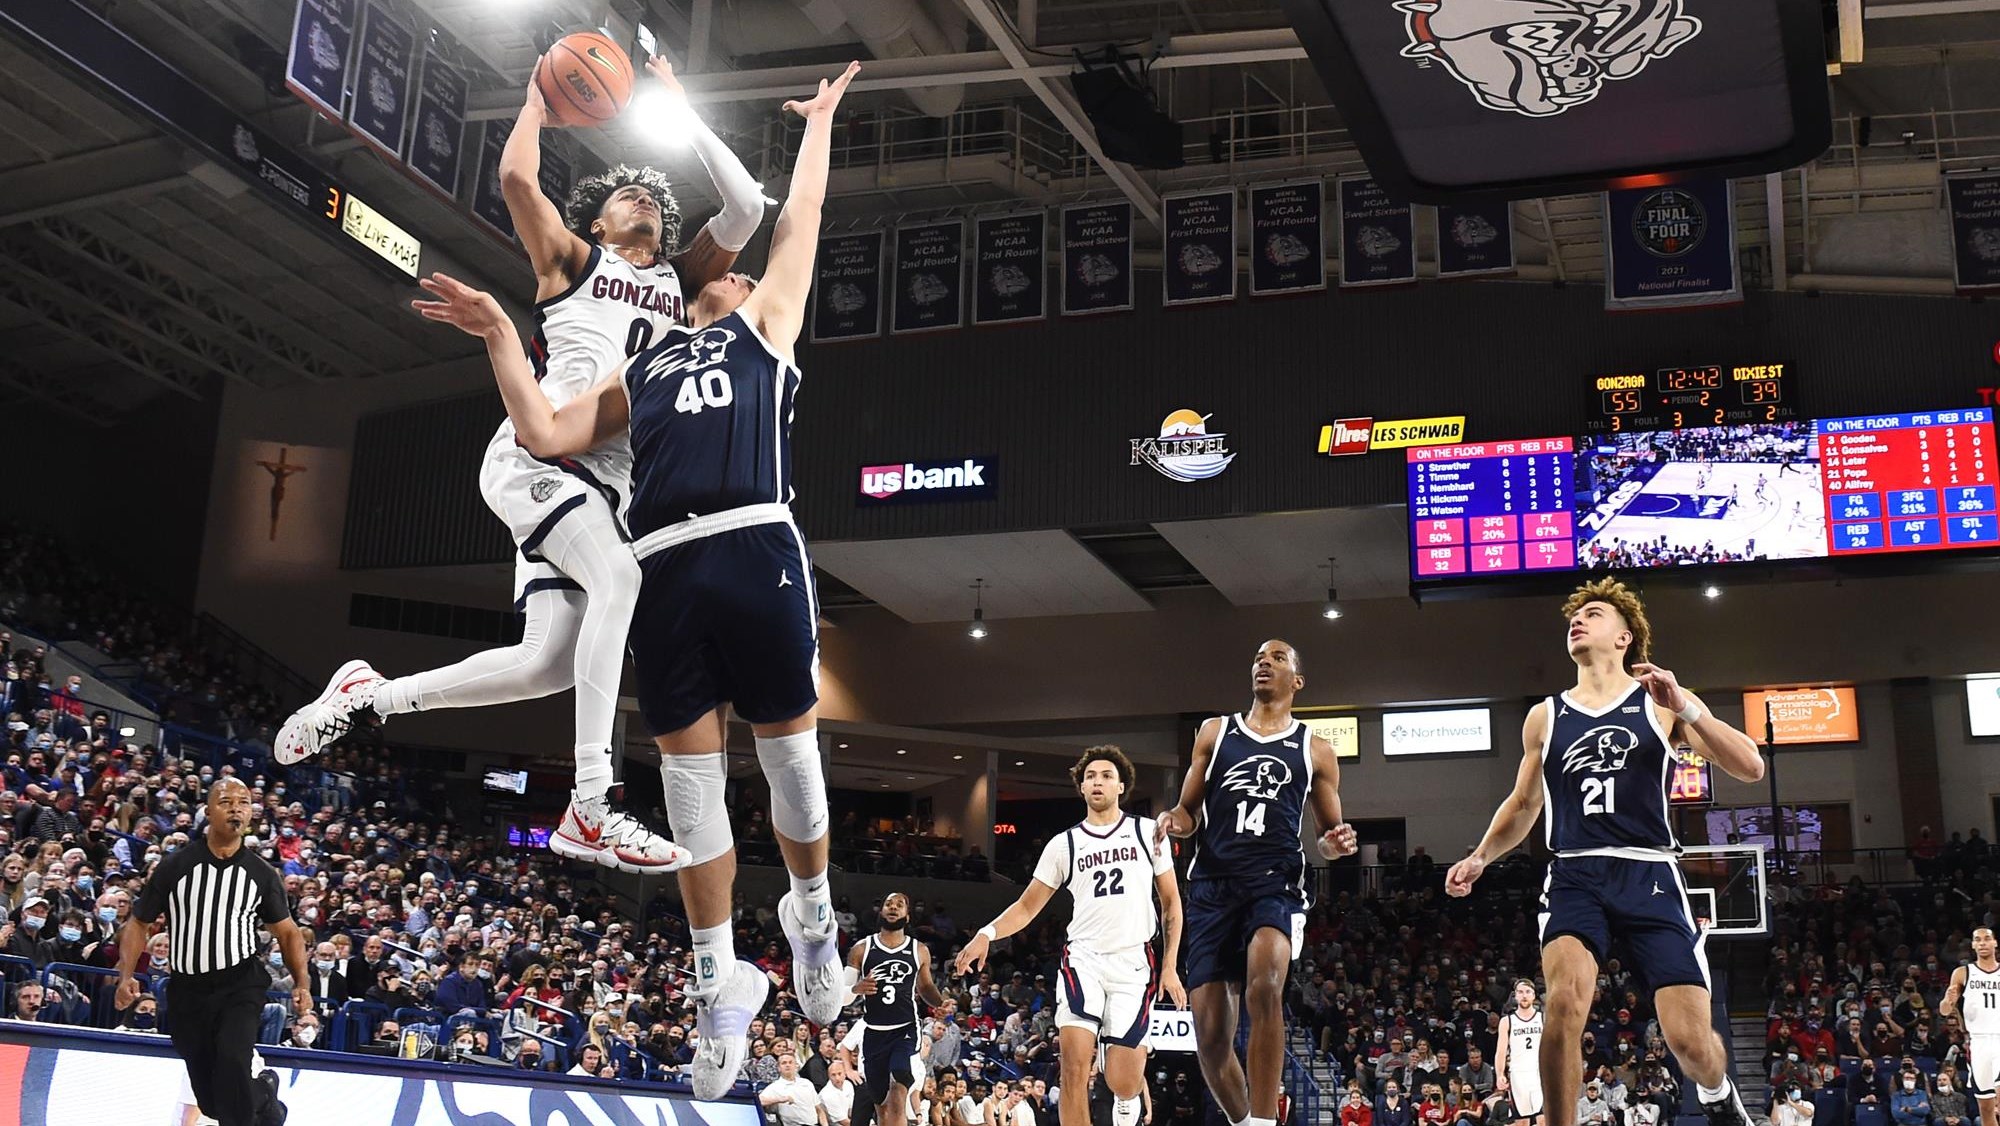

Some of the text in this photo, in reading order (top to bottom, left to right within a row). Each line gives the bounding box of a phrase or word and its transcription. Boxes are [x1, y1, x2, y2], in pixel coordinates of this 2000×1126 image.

[325, 187, 340, 220] 3
[1271, 205, 1303, 216] NCAA
[1648, 208, 1689, 222] FINAL
[1183, 215, 1216, 226] NCAA
[1257, 216, 1316, 228] First Round
[1082, 226, 1113, 236] NCAA
[1171, 225, 1229, 238] First Round
[1649, 223, 1690, 239] FOUR
[994, 236, 1027, 247] NCAA
[914, 246, 944, 256] NCAA
[983, 247, 1040, 260] 2nd Round
[835, 255, 864, 265] NCAA
[901, 255, 958, 269] 2nd Round
[1661, 266, 1684, 275] 2021
[1638, 278, 1710, 290] National Finalist
[592, 274, 682, 321] GONZAGA
[627, 317, 654, 359] 0
[1597, 375, 1645, 390] GONZAGA
[1668, 368, 1719, 389] 12:42
[674, 368, 733, 415] 40
[1753, 382, 1777, 401] 39
[1612, 392, 1638, 411] 55
[1672, 395, 1699, 404] PERIOD
[1700, 391, 1709, 406] 2
[1715, 409, 1724, 424] 2
[1727, 411, 1753, 420] FOULS
[1767, 406, 1776, 420] 2
[1912, 412, 1983, 425] PTS REB FLS
[1612, 416, 1620, 431] 3
[1634, 417, 1659, 425] FOULS
[1674, 412, 1682, 426] 3
[1827, 418, 1899, 431] ON THE FLOOR
[1334, 423, 1370, 447] Tires
[1374, 423, 1460, 442] LES SCHWAB
[1840, 435, 1876, 444] Gooden
[1417, 446, 1484, 459] ON THE FLOOR
[1496, 441, 1563, 453] PTS REB FLS
[1826, 448, 1838, 456] 11
[1827, 458, 1839, 466] 14
[1429, 473, 1459, 482] Timme
[1828, 470, 1840, 478] 21
[1844, 469, 1867, 479] Pope
[1430, 482, 1474, 492] Nembhard
[1829, 482, 1841, 490] 40
[1902, 492, 1924, 502] 3FG
[1963, 489, 1976, 498] FT
[1430, 495, 1468, 504] Hickman
[1849, 495, 1863, 505] FG
[1958, 500, 1983, 510] 36%
[1417, 508, 1428, 516] 22
[1431, 506, 1463, 515] Watson
[1845, 507, 1869, 517] 34%
[1901, 503, 1925, 514] 31%
[1484, 518, 1503, 527] 3FG
[1541, 514, 1552, 524] FT
[1962, 518, 1982, 528] STL
[1433, 521, 1446, 530] FG
[1536, 526, 1559, 536] 67%
[1847, 525, 1869, 535] REB
[1905, 521, 1925, 531] AST
[1429, 533, 1452, 542] 50%
[1482, 530, 1505, 540] 20%
[1852, 537, 1866, 547] 24
[1431, 549, 1451, 558] REB
[1485, 546, 1503, 555] AST
[1539, 543, 1557, 553] STL
[1435, 562, 1449, 571] 32
[1489, 558, 1502, 568] 14
[1765, 692, 1818, 701] Advanced
[1778, 708, 1812, 717] SKIN
[1311, 727, 1355, 736] RGENT
[1411, 725, 1483, 738] Northwest
[1580, 776, 1616, 816] 21
[1235, 800, 1266, 836] 14
[1077, 846, 1138, 873] GONZAGA
[1093, 867, 1124, 898] 22
[882, 985, 895, 1005] 3
[1982, 992, 1996, 1009] 11
[1151, 1020, 1194, 1037] EAD
[1513, 1026, 1542, 1037] GONZAGA
[1525, 1037, 1533, 1050] 2
